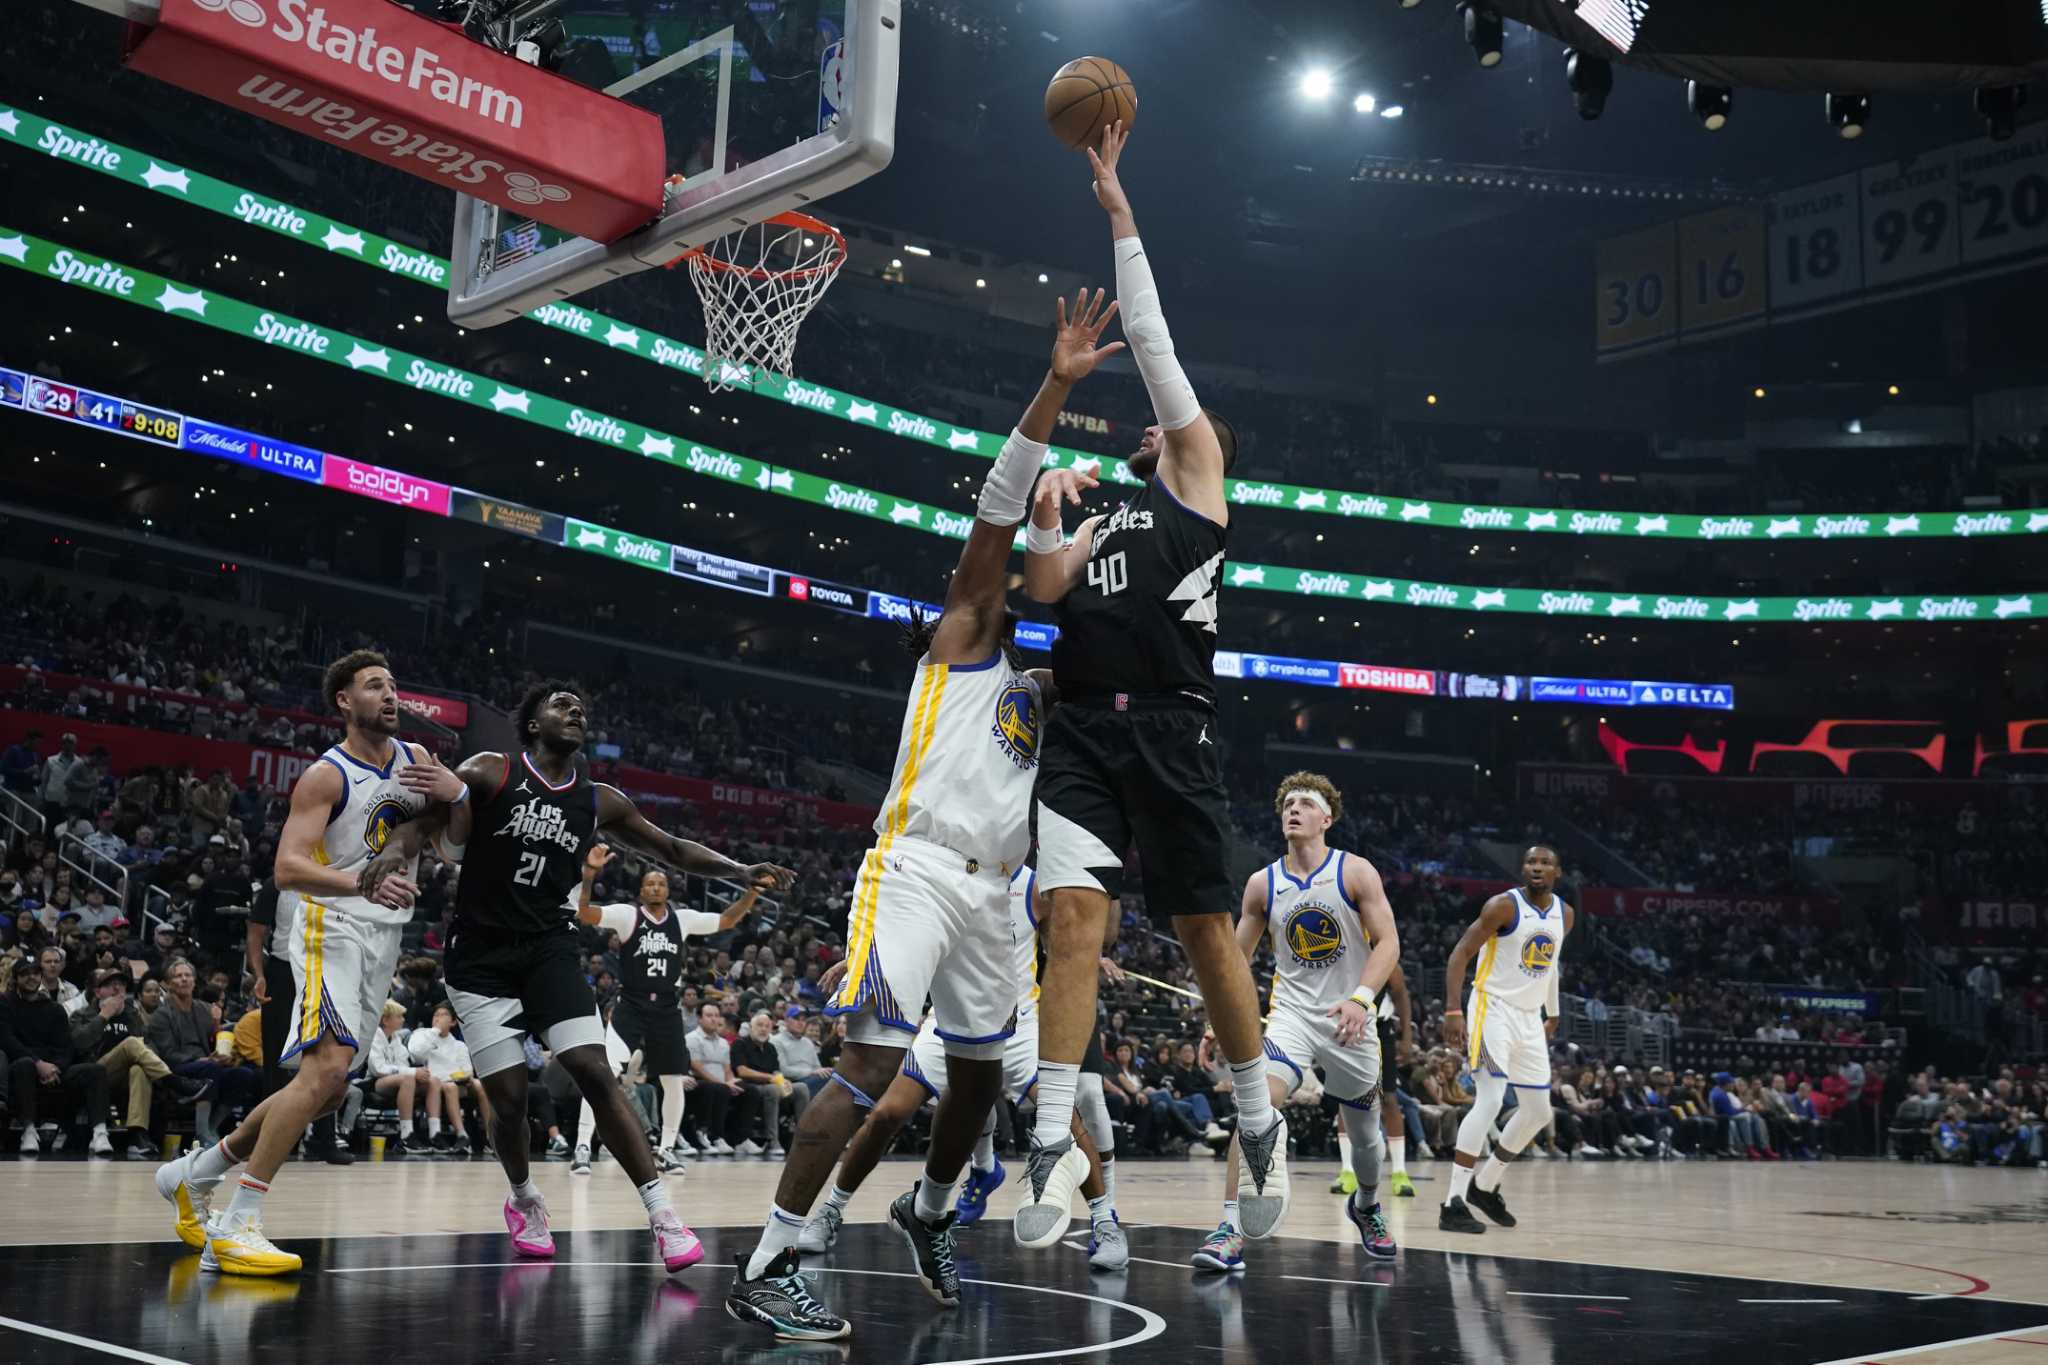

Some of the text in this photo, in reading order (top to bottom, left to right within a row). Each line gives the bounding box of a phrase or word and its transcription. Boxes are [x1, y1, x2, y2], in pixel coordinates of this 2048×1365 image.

[38, 126, 121, 170] Sprite
[234, 194, 307, 235] Sprite
[1974, 173, 2048, 240] 20
[1872, 199, 1947, 264] 99
[379, 244, 446, 283] Sprite
[1787, 227, 1840, 285] 18
[48, 251, 136, 296] Sprite
[1696, 250, 1744, 305] 16
[1605, 272, 1663, 326] 30
[533, 303, 593, 333] Sprite
[254, 313, 330, 354] Sprite
[650, 339, 703, 372] Sprite
[405, 360, 475, 398] Sprite
[44, 390, 72, 413] 29
[783, 381, 837, 406] Sprite
[90, 402, 114, 424] 41
[122, 415, 134, 430] 2
[888, 410, 937, 439] Sprite
[134, 413, 178, 441] 9:08
[566, 409, 627, 445] Sprite
[188, 429, 316, 473] Michelob ULTRA
[686, 447, 743, 479] Sprite
[347, 464, 430, 503] boldyn
[1231, 482, 1284, 506] Sprite
[825, 483, 879, 514] Sprite
[1337, 495, 1389, 517] Sprite
[932, 511, 974, 540] Sprit
[1460, 507, 1513, 529] Sprite
[1568, 512, 1623, 535] Sprite
[1699, 518, 1754, 540] Sprite
[1814, 515, 1871, 539] Sprite
[1953, 514, 2013, 537] Sprite
[614, 536, 662, 562] Sprite
[1087, 550, 1128, 597] 40
[1296, 572, 1351, 595] Sprite
[810, 585, 853, 606] TOYOTA
[1407, 582, 1459, 606] Sprite
[1537, 592, 1595, 615] Sprite
[1654, 596, 1710, 620] Sprite
[1793, 598, 1853, 622] Sprite
[1917, 598, 1978, 621] Sprite
[1270, 662, 1330, 678] crypto.com
[1343, 668, 1430, 690] TOSHIBA
[1586, 686, 1629, 698] ULTRA
[1660, 687, 1726, 704] DELTA
[364, 792, 392, 816] GOLDEN
[524, 796, 563, 825] Los
[493, 804, 580, 854] Angeles
[513, 851, 547, 887] 21
[1281, 901, 1335, 924] GOLDEN STATE
[1641, 897, 1780, 916] CLIPPERS.COM
[646, 929, 667, 941] Los
[1319, 919, 1330, 935] 2
[633, 935, 679, 957] Angeles
[1292, 944, 1346, 969] WARRIORS
[647, 958, 668, 977] 24
